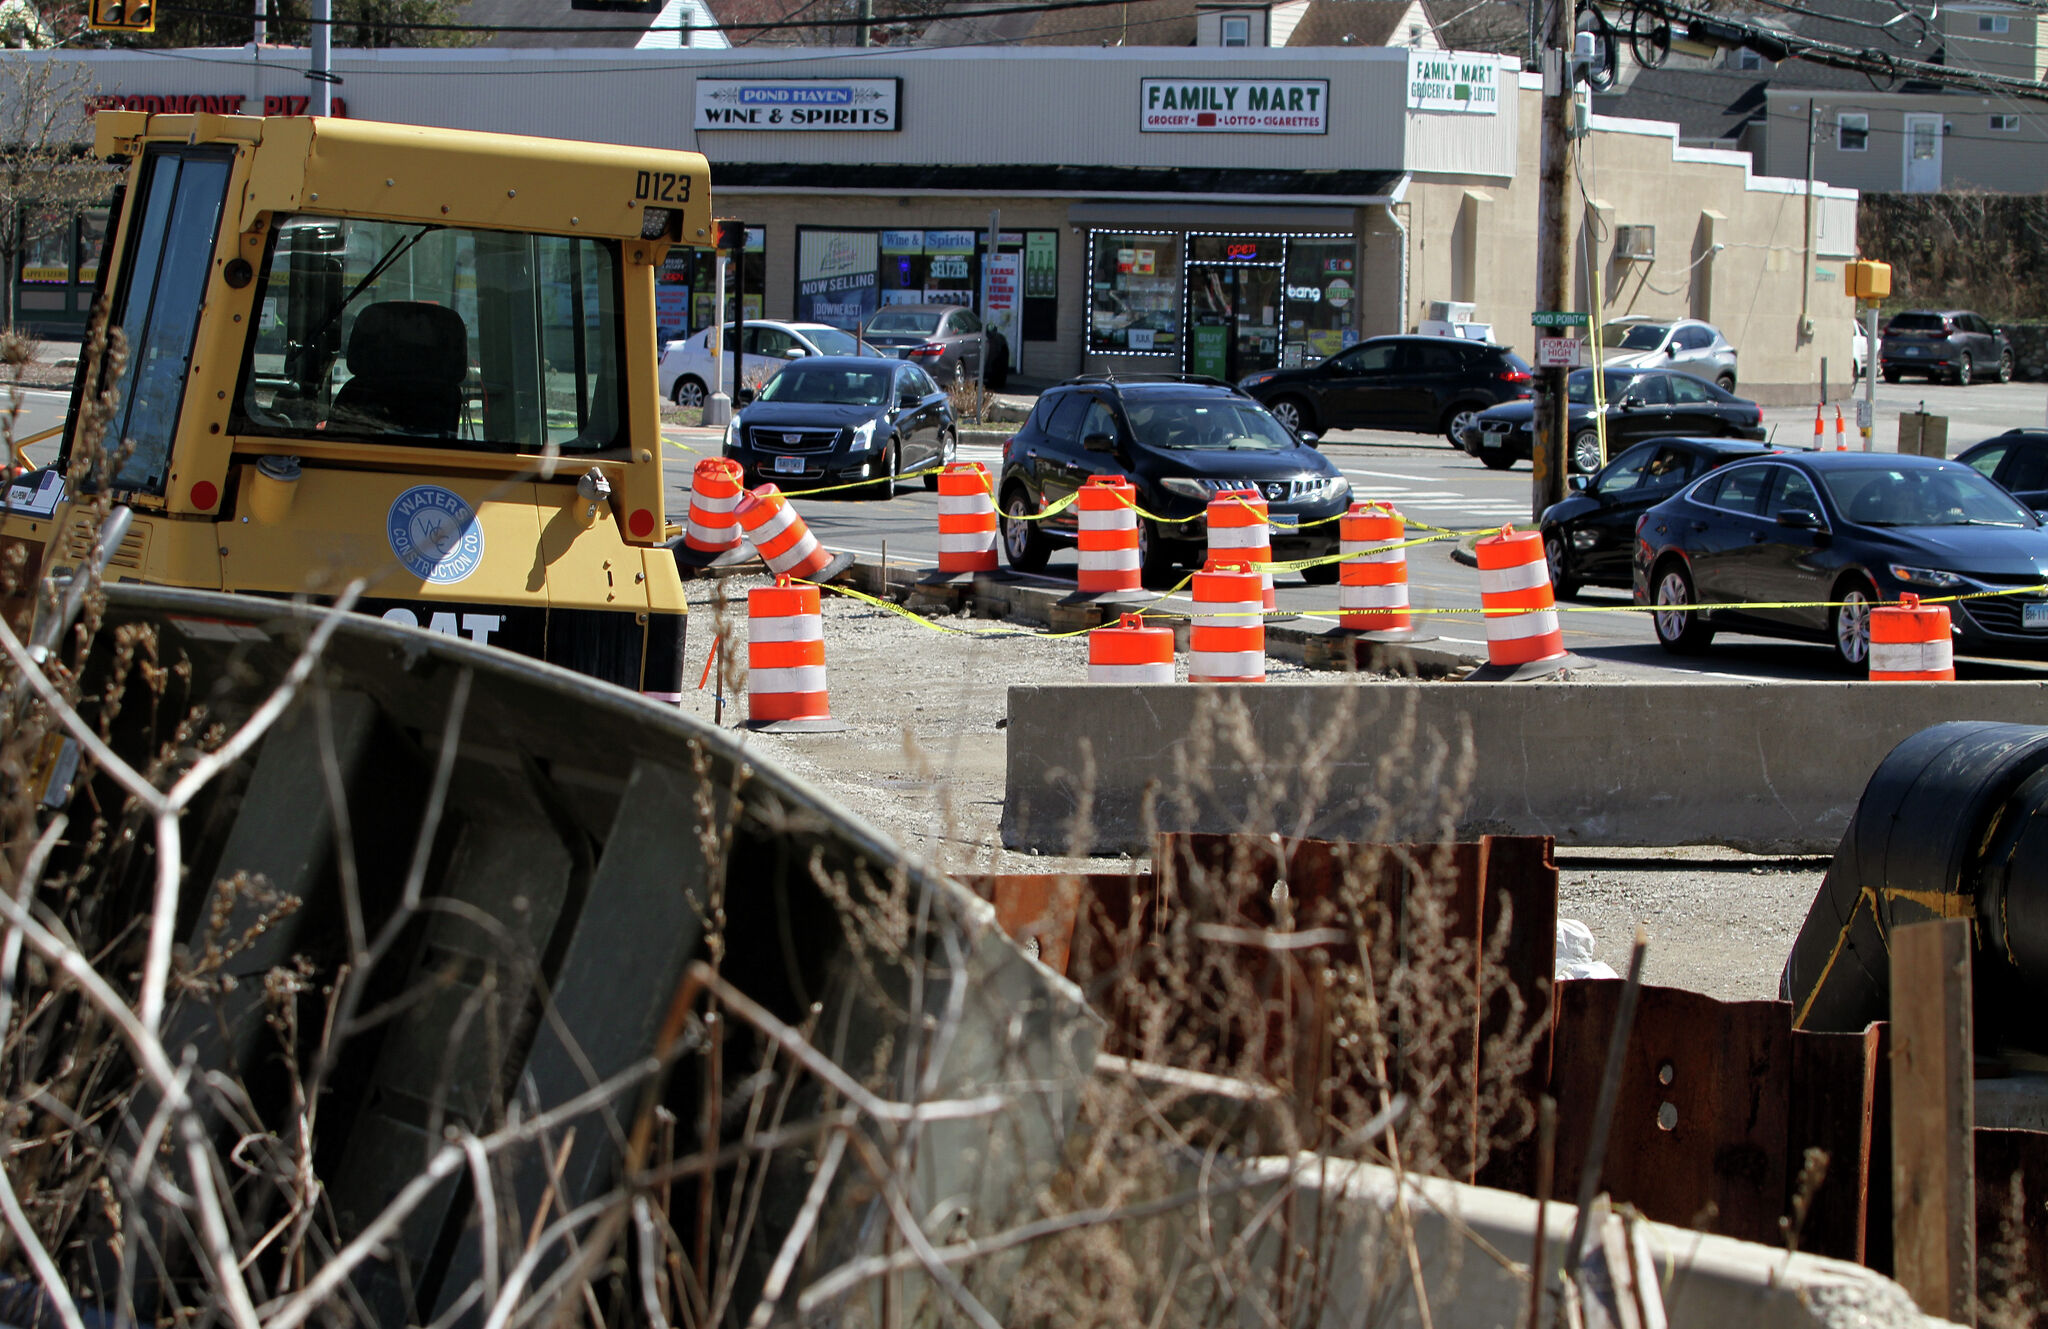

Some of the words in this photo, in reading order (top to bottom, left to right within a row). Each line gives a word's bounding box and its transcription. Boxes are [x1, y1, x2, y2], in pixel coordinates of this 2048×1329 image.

[1417, 61, 1457, 81] FAMILY
[1462, 64, 1493, 83] MART
[744, 90, 789, 101] POND
[794, 90, 848, 101] HAVEN
[1149, 86, 1239, 111] FAMILY
[1249, 87, 1320, 112] MART
[1412, 82, 1445, 99] GROCERY
[1474, 86, 1496, 102] LOTTO
[264, 94, 348, 118] PIZA
[705, 108, 761, 123] WINE
[769, 108, 783, 124] &
[790, 108, 889, 124] SPIRITS
[1148, 115, 1189, 126] GROCERY
[1224, 115, 1256, 126] LOTTO
[1264, 116, 1320, 127] CIGARETTES
[635, 170, 692, 203] D123
[886, 231, 909, 246] Wine
[911, 232, 919, 246] &
[929, 231, 972, 248] Spirits
[930, 261, 969, 278] SELTZER
[802, 281, 827, 295] NOW
[830, 273, 875, 292] SELLING
[1287, 284, 1321, 303] bang
[816, 303, 860, 316] DOWNEAST
[1532, 315, 1554, 324] POND
[1556, 315, 1579, 324] POINT
[1198, 332, 1223, 344] BUY
[1543, 339, 1576, 349] FORAN
[1547, 349, 1571, 357] HIGH
[399, 491, 469, 521] WATERS
[393, 527, 473, 578] CONSTRUCTION
